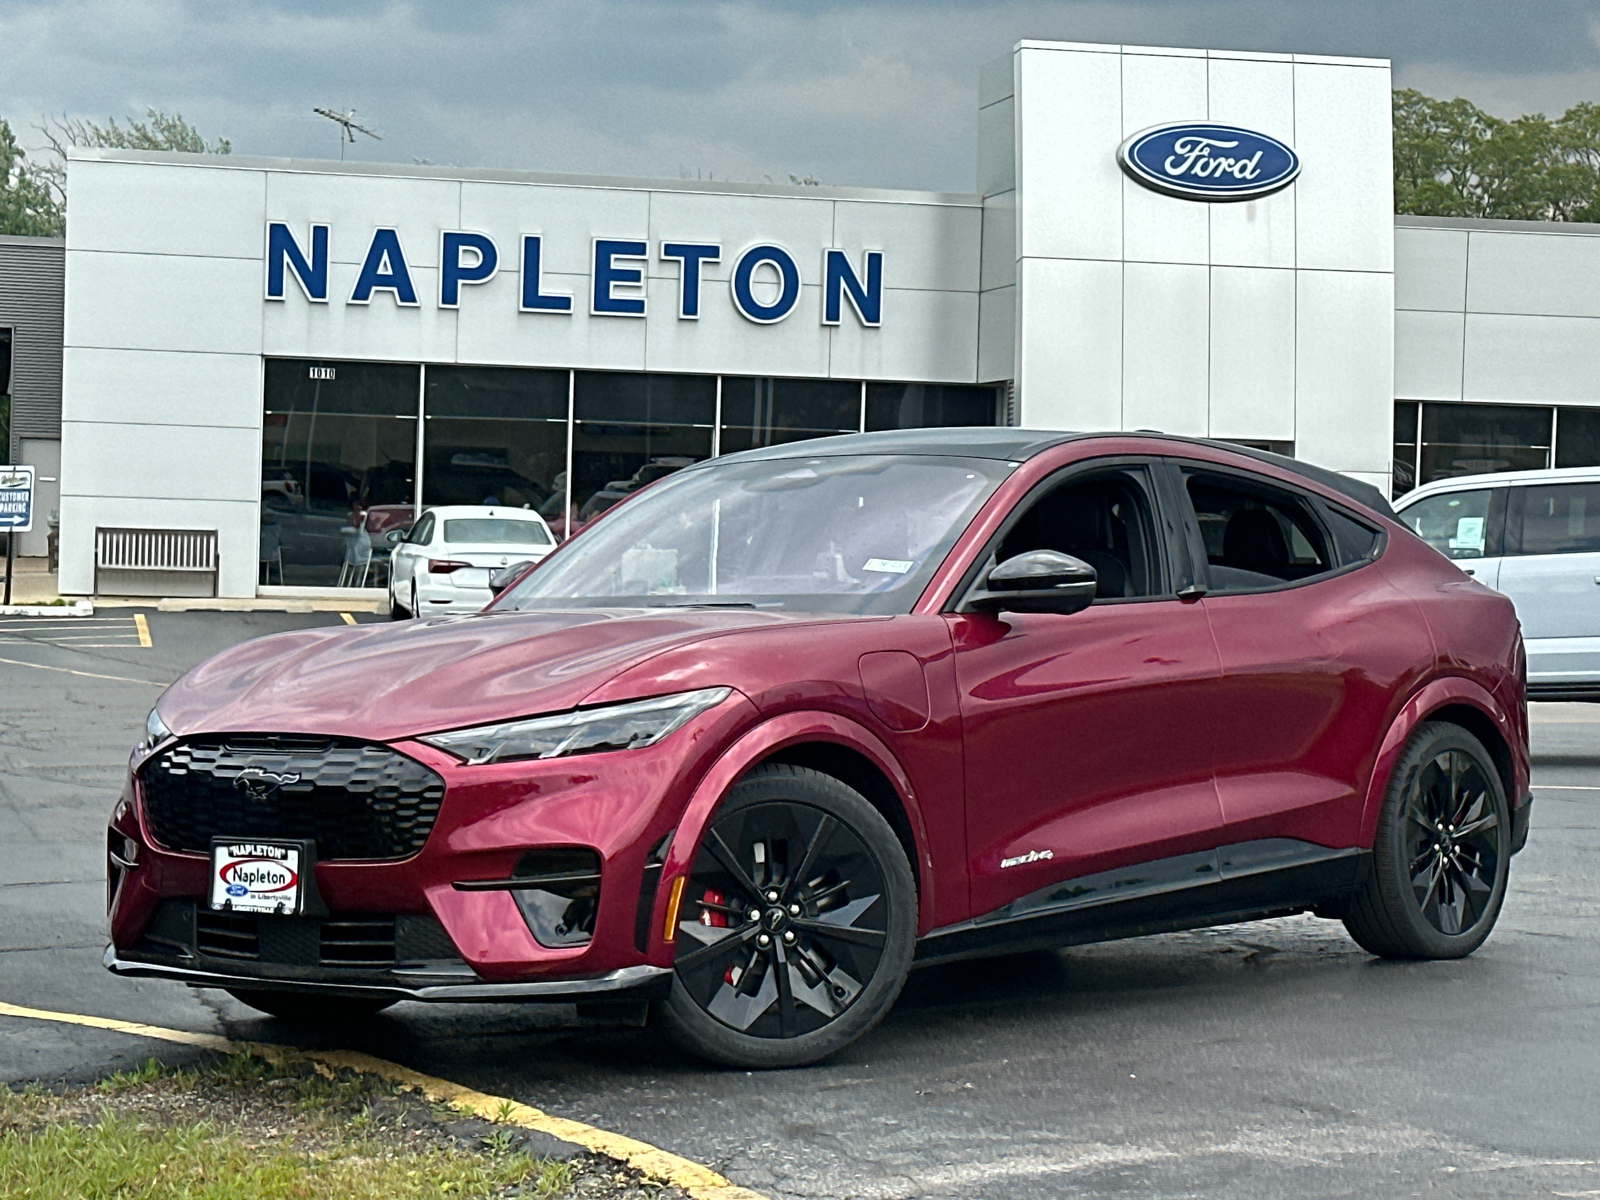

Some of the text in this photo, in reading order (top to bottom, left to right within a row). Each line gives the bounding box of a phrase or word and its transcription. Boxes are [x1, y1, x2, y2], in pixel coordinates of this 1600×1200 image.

[1164, 136, 1264, 180] Ford
[264, 220, 886, 327] NAPLETON
[311, 367, 335, 379] 1010
[233, 866, 286, 887] Napleton
